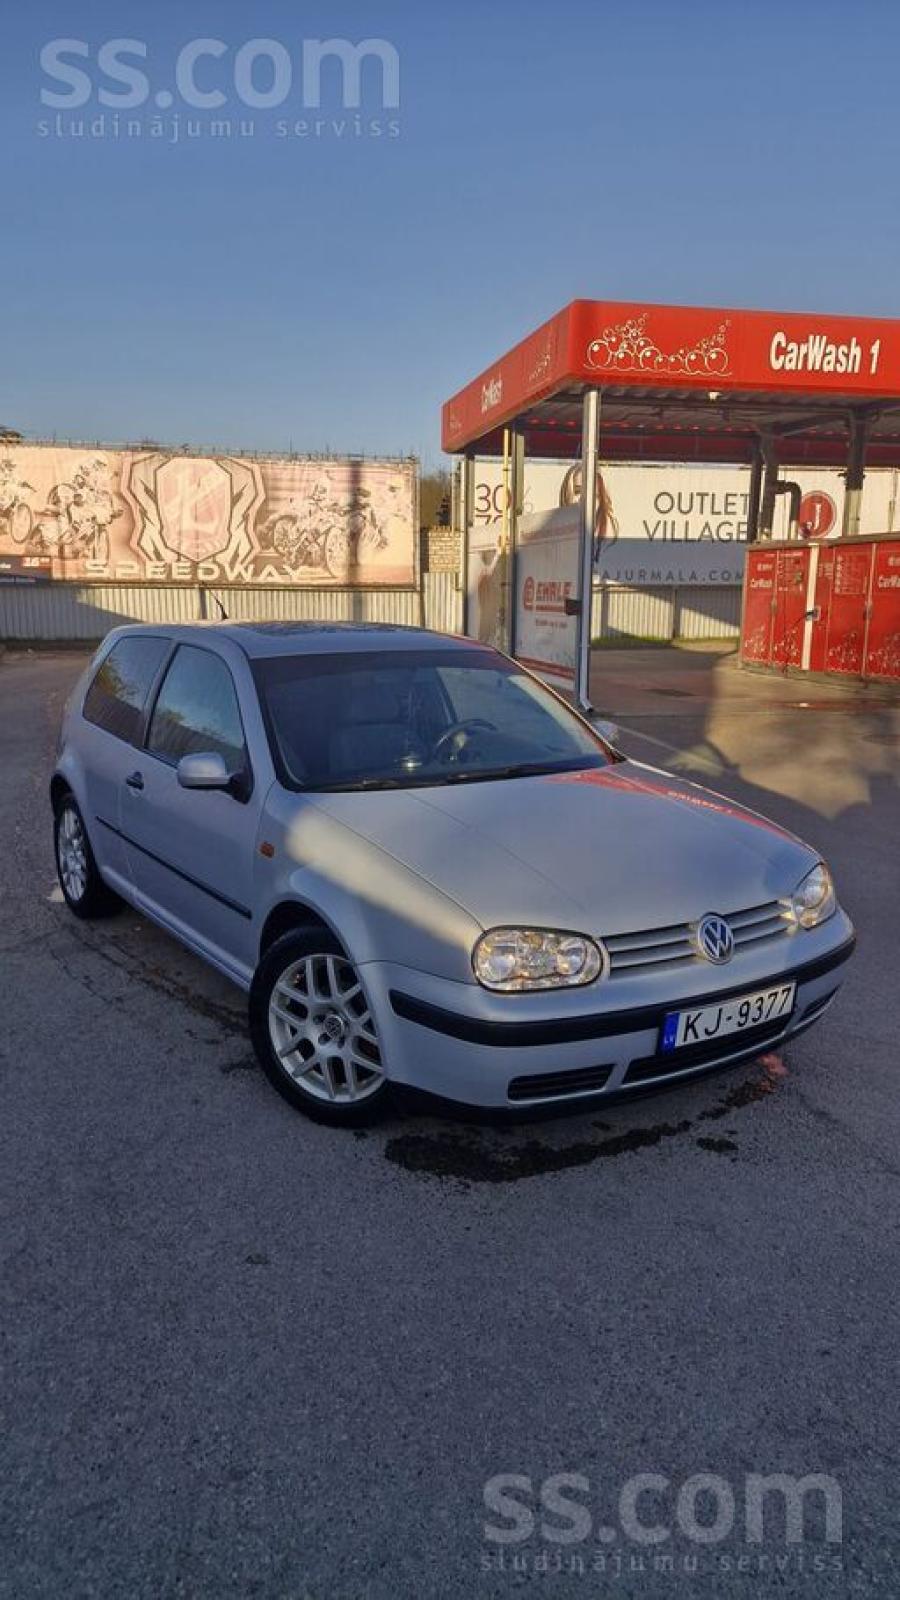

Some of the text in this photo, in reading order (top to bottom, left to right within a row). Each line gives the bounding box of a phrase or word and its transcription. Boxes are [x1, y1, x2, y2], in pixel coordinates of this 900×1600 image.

[770, 331, 880, 374] CarWash 1
[654, 491, 750, 516] OUTLET
[643, 519, 749, 544] VILLAGE
[84, 561, 303, 583] SPEEDWAY
[683, 986, 792, 1043] KJ-9377
